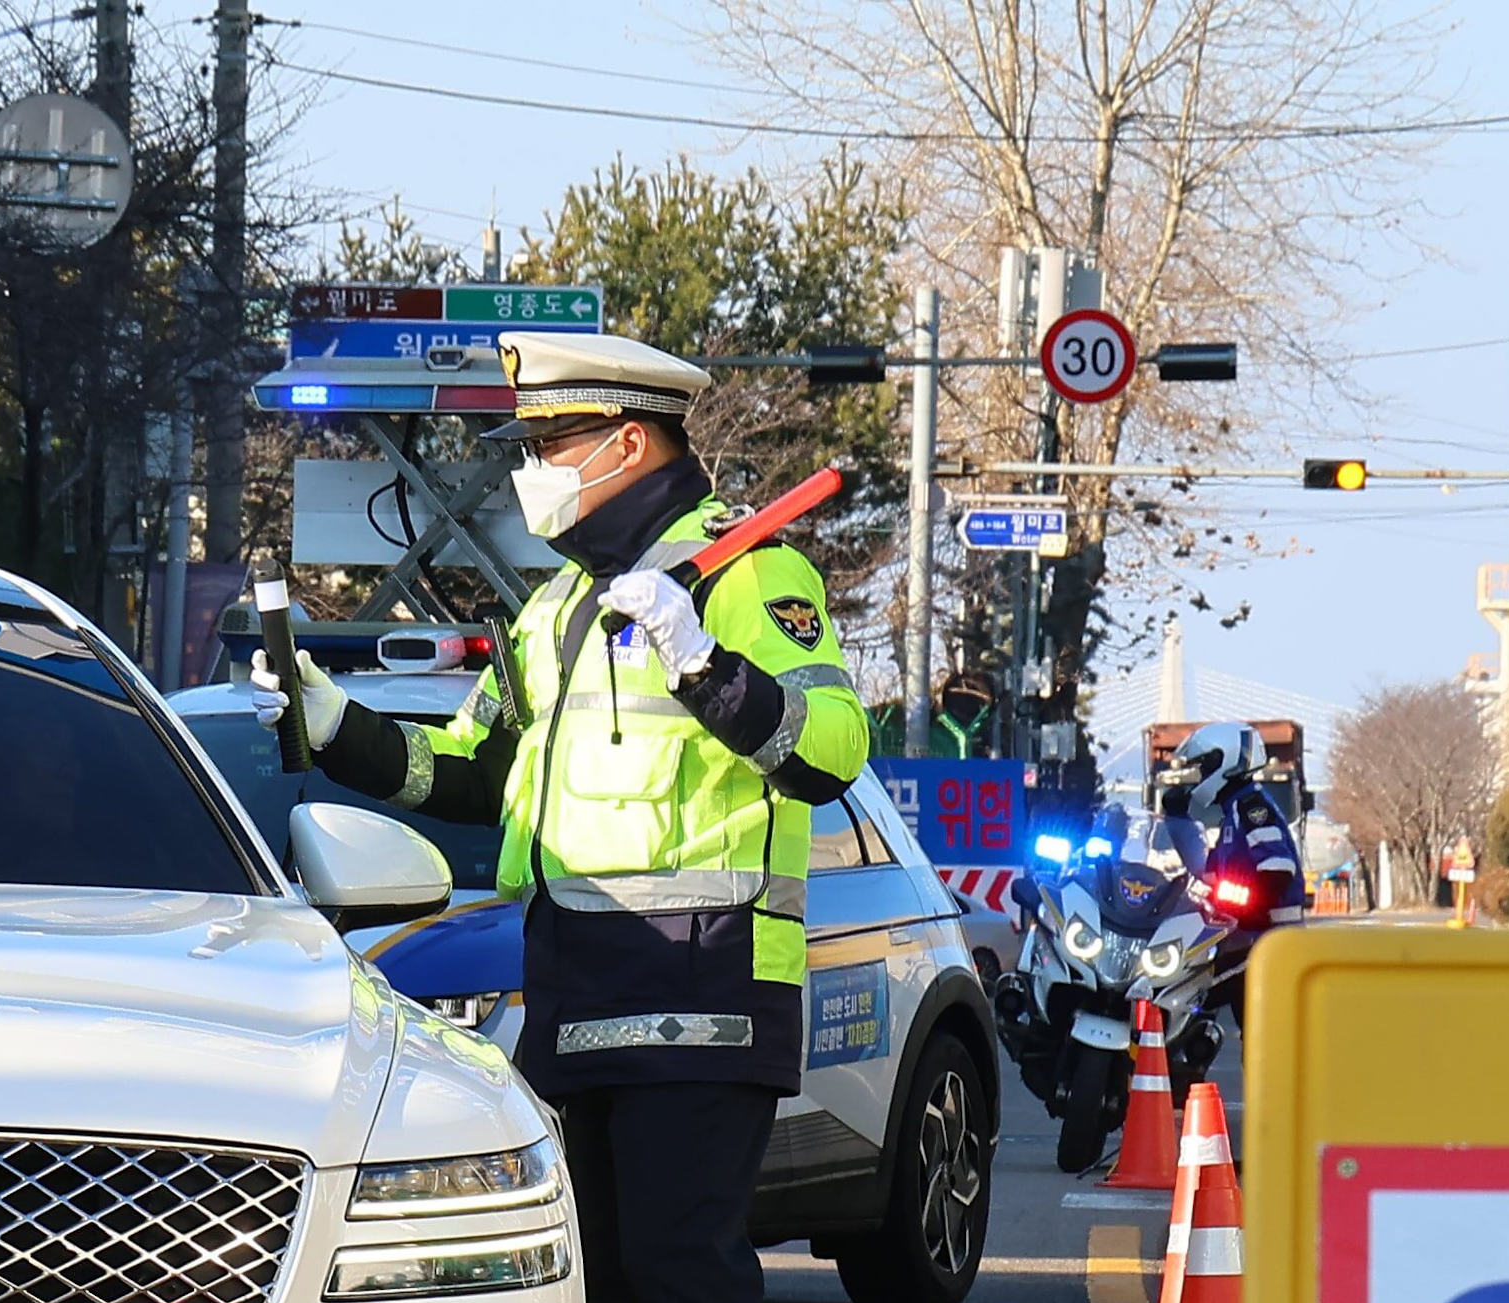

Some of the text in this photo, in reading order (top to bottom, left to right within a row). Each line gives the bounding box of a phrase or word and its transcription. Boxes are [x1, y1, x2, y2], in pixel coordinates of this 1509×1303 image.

[494, 293, 564, 318] 영종도
[1062, 337, 1116, 376] 30
[1011, 514, 1059, 533] 월미로
[938, 777, 1012, 848] 위험
